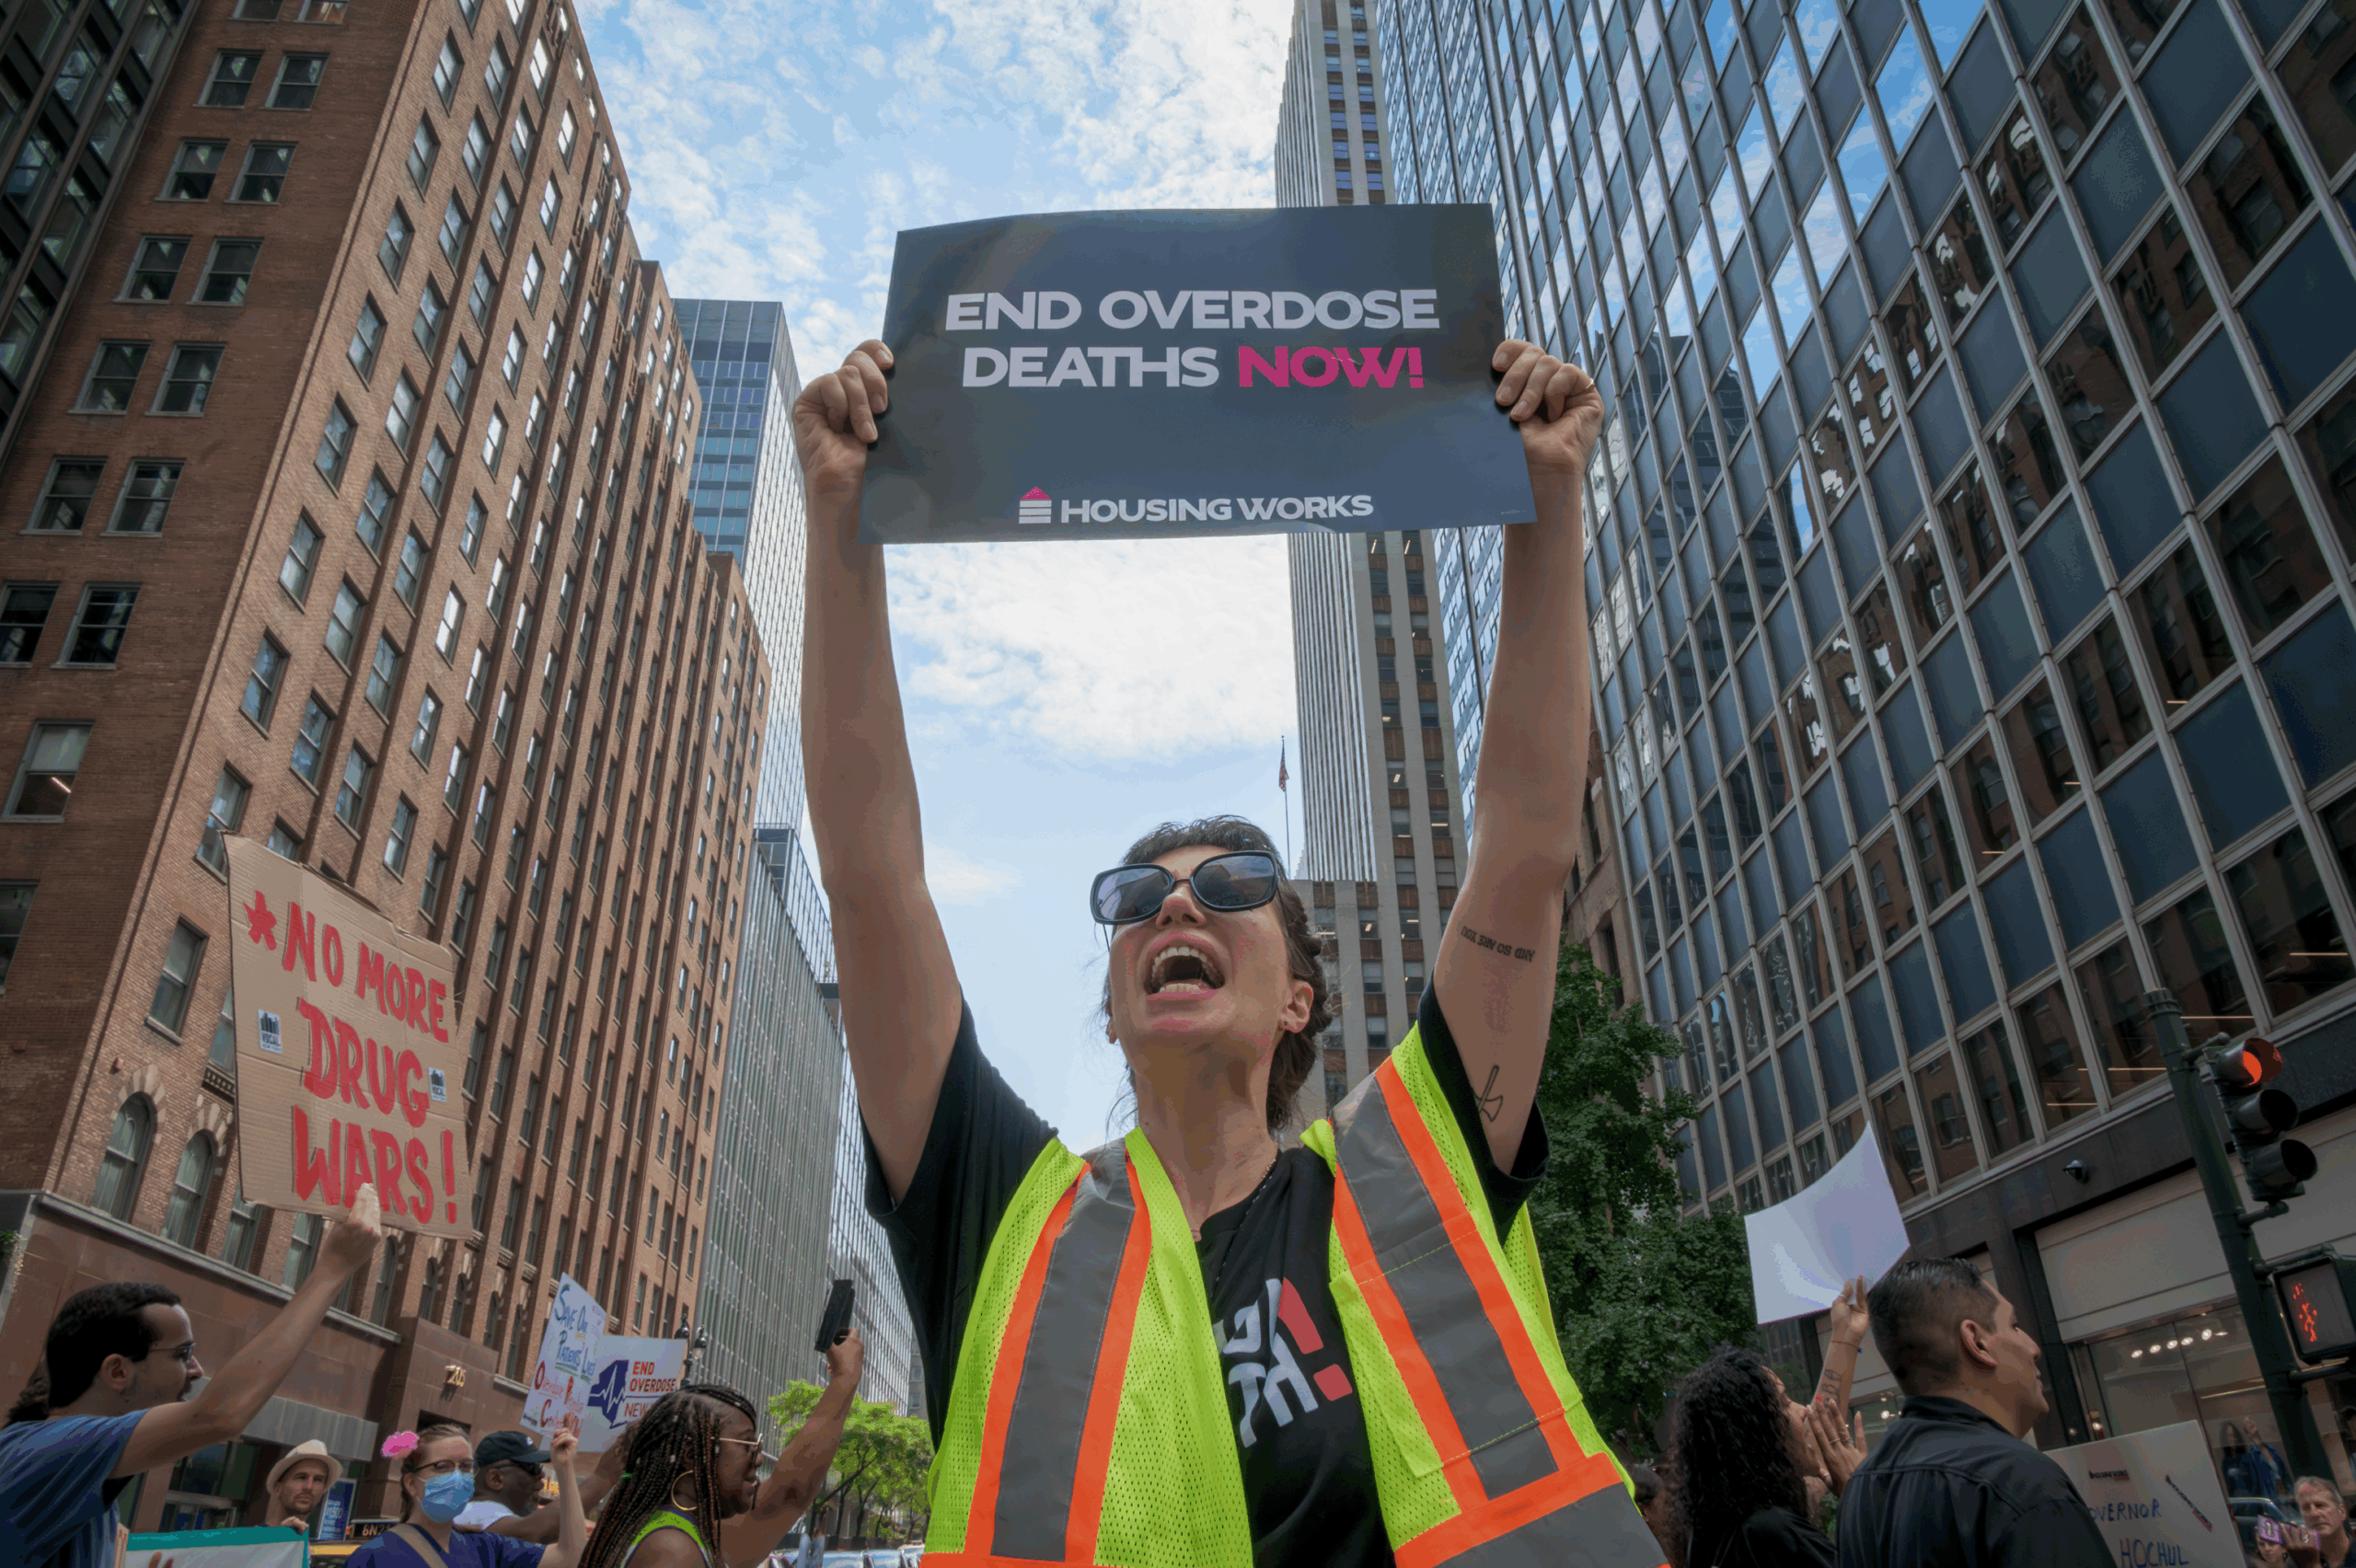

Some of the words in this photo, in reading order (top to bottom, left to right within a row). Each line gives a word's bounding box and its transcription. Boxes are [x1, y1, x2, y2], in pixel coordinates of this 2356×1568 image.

[945, 292, 1081, 331] END
[1098, 289, 1440, 329] OVERDOSE
[962, 346, 1219, 387] DEATHS
[1238, 345, 1424, 388] NOW!
[1060, 498, 1232, 523] HOUSING
[1236, 494, 1374, 519] WORKS
[1461, 926, 1477, 943] YOU
[1477, 934, 1497, 951] ARE
[1496, 943, 1512, 956] SO
[1514, 947, 1536, 963] AND
[356, 941, 449, 1043] MORE
[297, 997, 431, 1128] DRUG
[293, 1104, 456, 1225] WARS!
[632, 1361, 655, 1375] END
[629, 1378, 676, 1392] OVERDOSE
[623, 1402, 648, 1417] NEW
[2087, 1497, 2162, 1522] OVERNOR
[2119, 1537, 2189, 1568] HOCHUL
